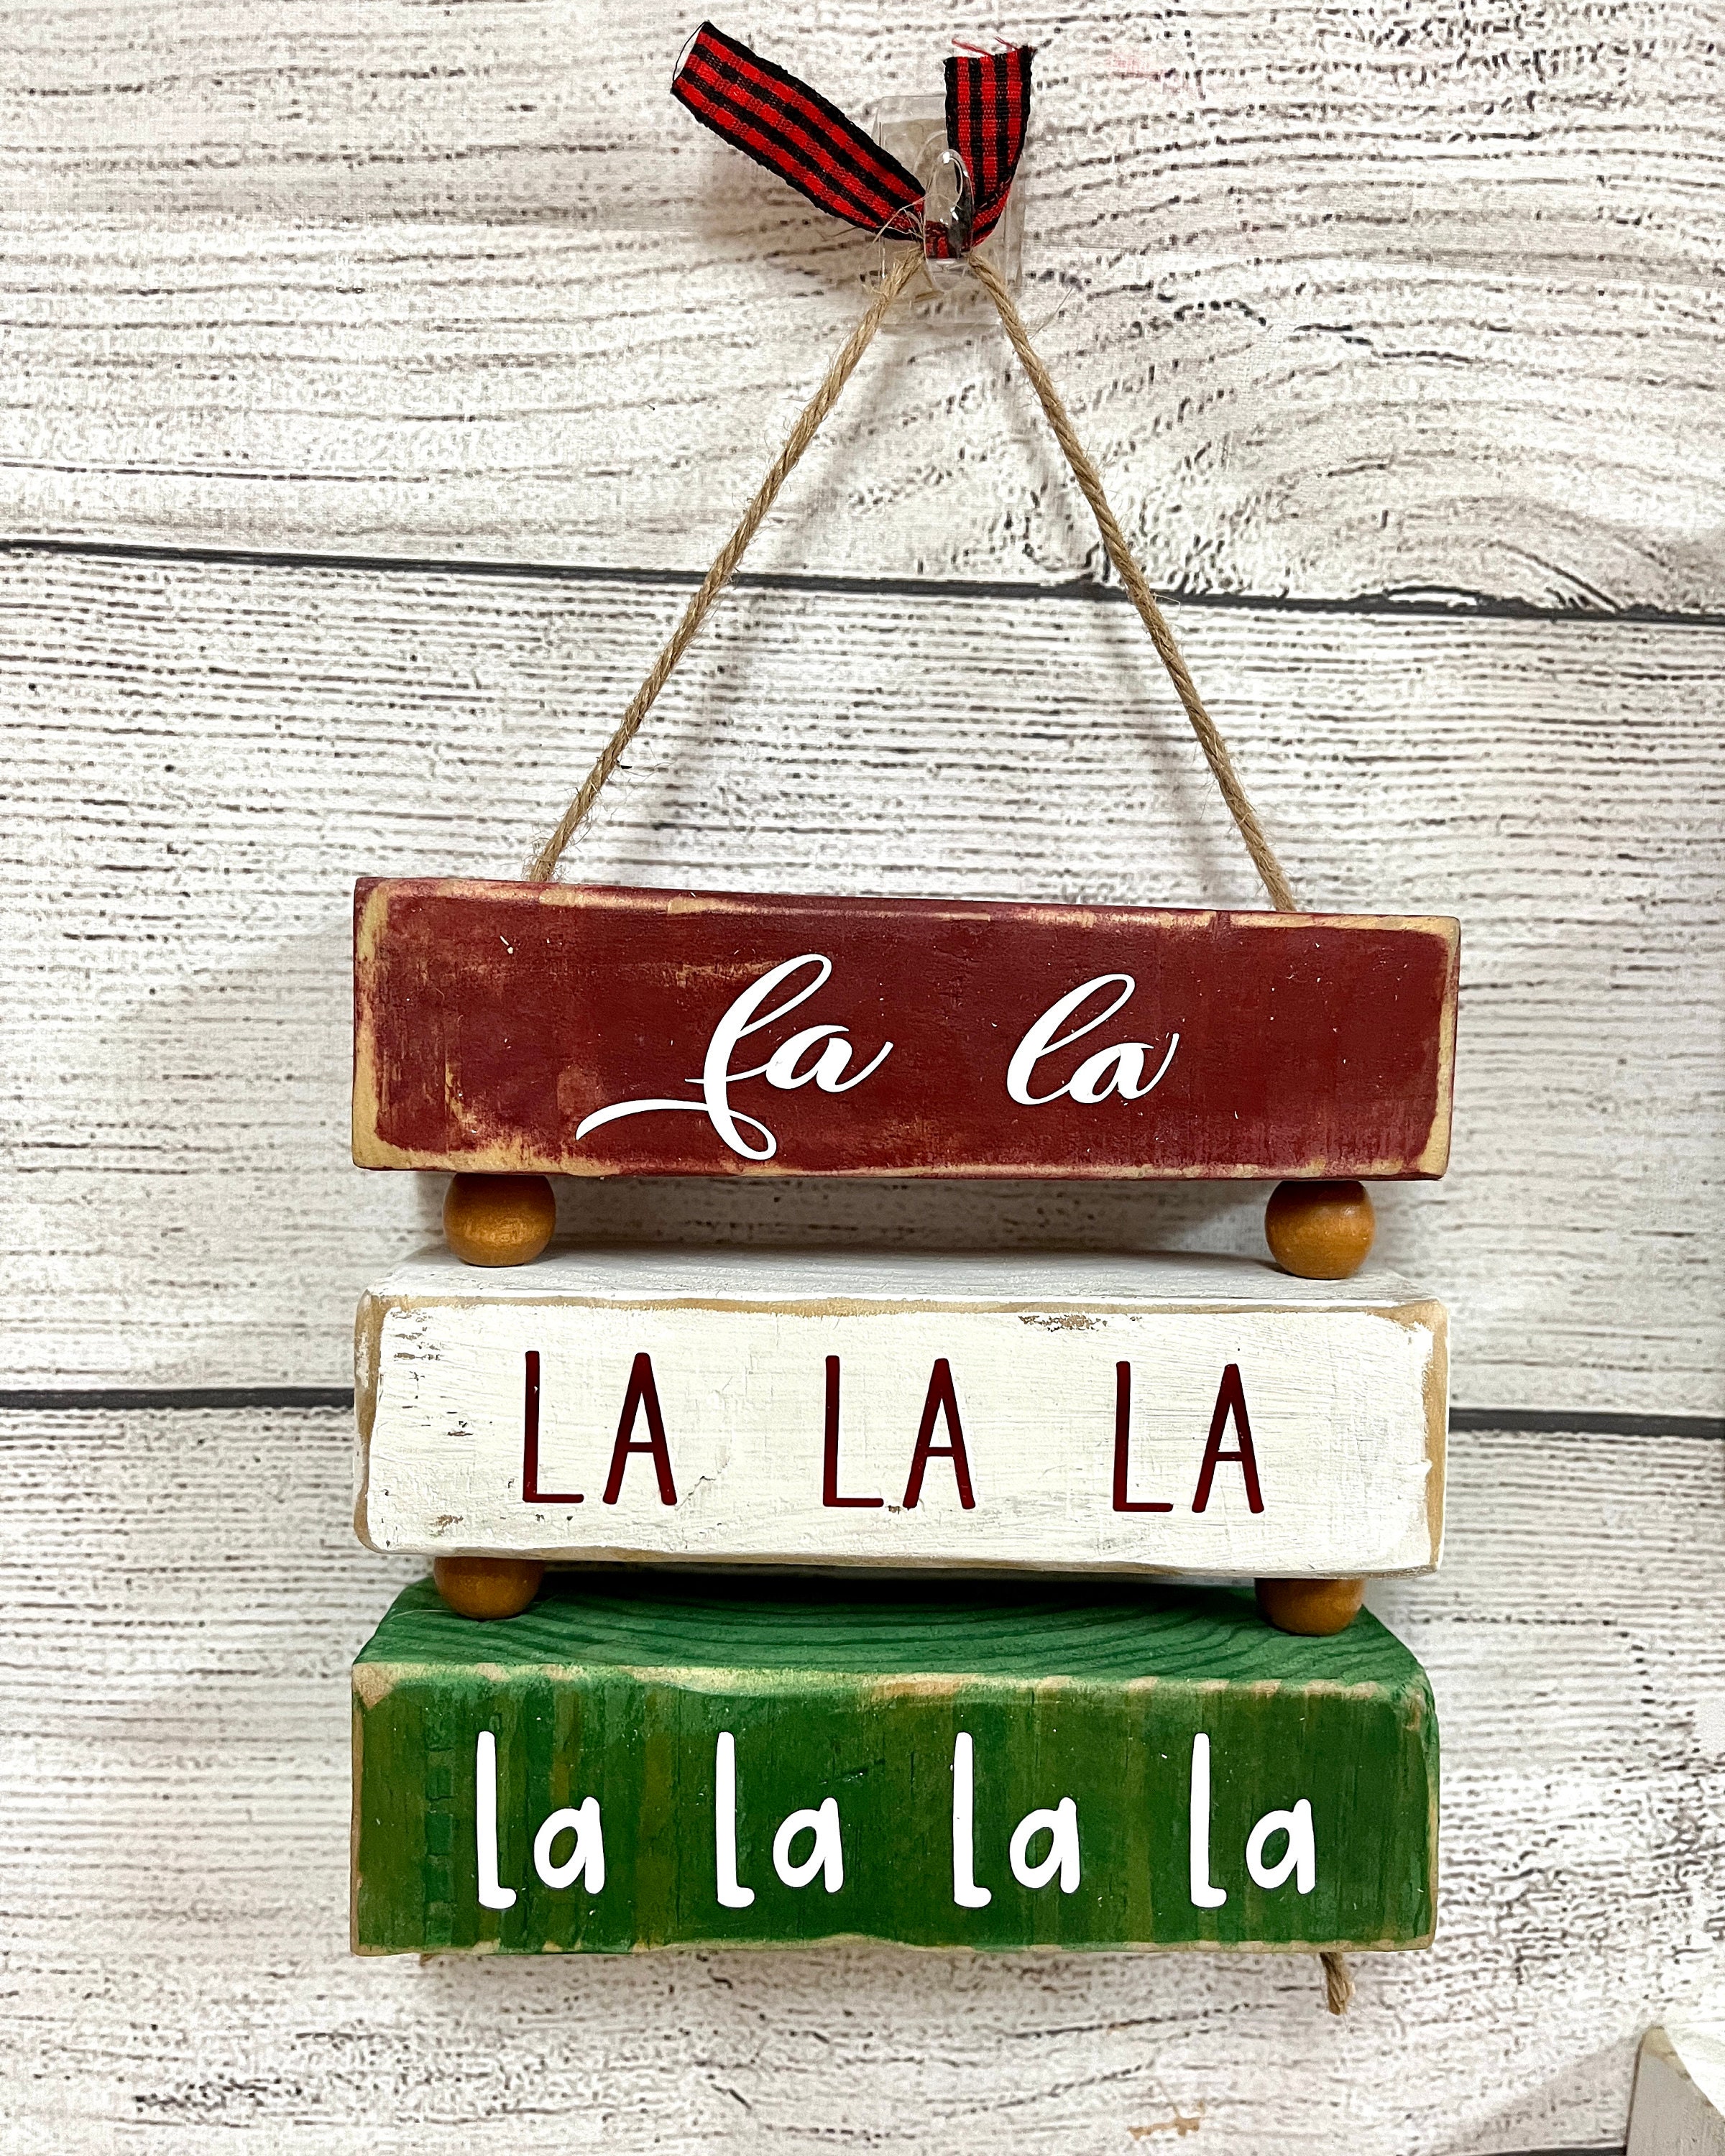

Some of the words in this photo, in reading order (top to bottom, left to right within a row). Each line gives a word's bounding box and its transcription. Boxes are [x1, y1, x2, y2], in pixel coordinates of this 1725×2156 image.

[1006, 974, 1180, 1106] la
[522, 1350, 678, 1506] LA
[822, 1355, 976, 1511] LA
[1112, 1360, 1265, 1514] LA
[476, 1731, 605, 1909] la
[715, 1731, 844, 1908] la
[952, 1731, 1080, 1908] la
[1190, 1733, 1315, 1909] la
